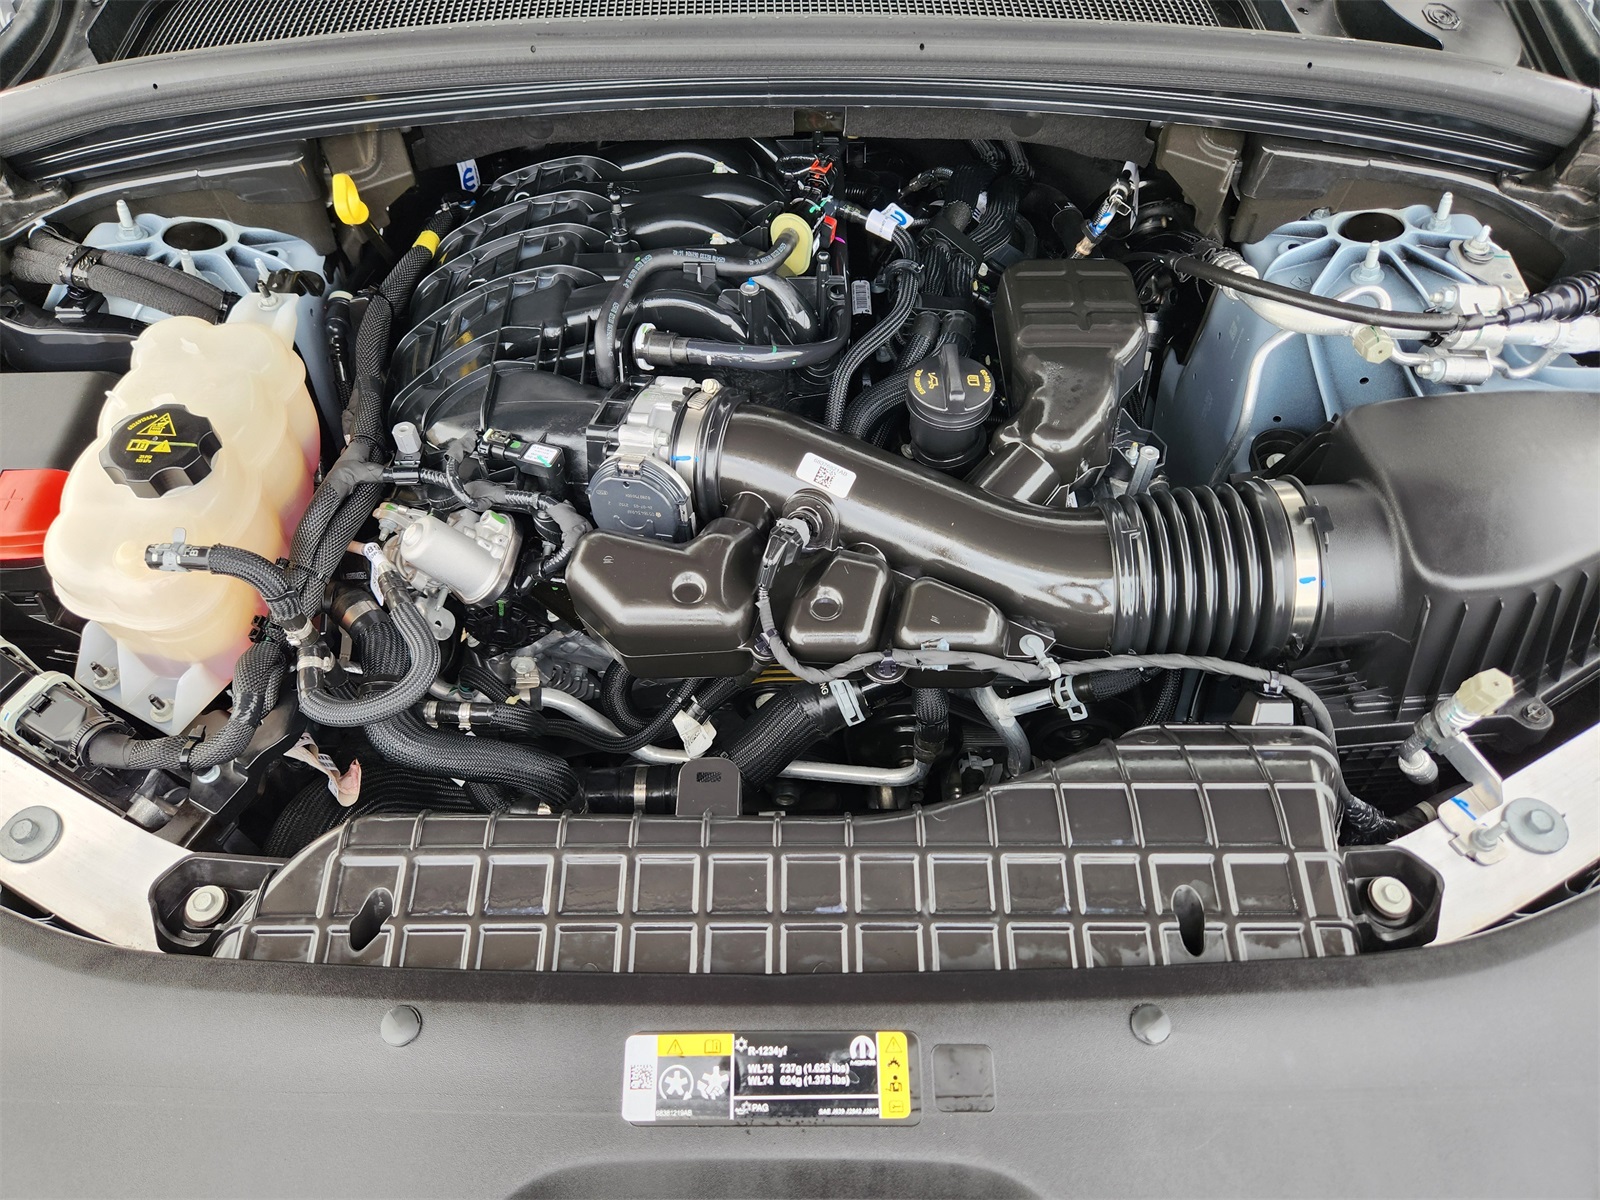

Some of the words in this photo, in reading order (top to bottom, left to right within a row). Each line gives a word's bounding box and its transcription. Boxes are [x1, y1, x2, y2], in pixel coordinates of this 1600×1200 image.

[747, 1045, 788, 1058] R-1234yf
[747, 1063, 774, 1074] WL75
[780, 1063, 802, 1075] 737g
[803, 1063, 831, 1074] (1.625
[832, 1063, 850, 1074] lbs)
[747, 1075, 774, 1086] WL74
[779, 1075, 802, 1087] 624g
[803, 1075, 831, 1087] (1.375
[832, 1075, 850, 1087] lbs)
[752, 1103, 769, 1112] PAG
